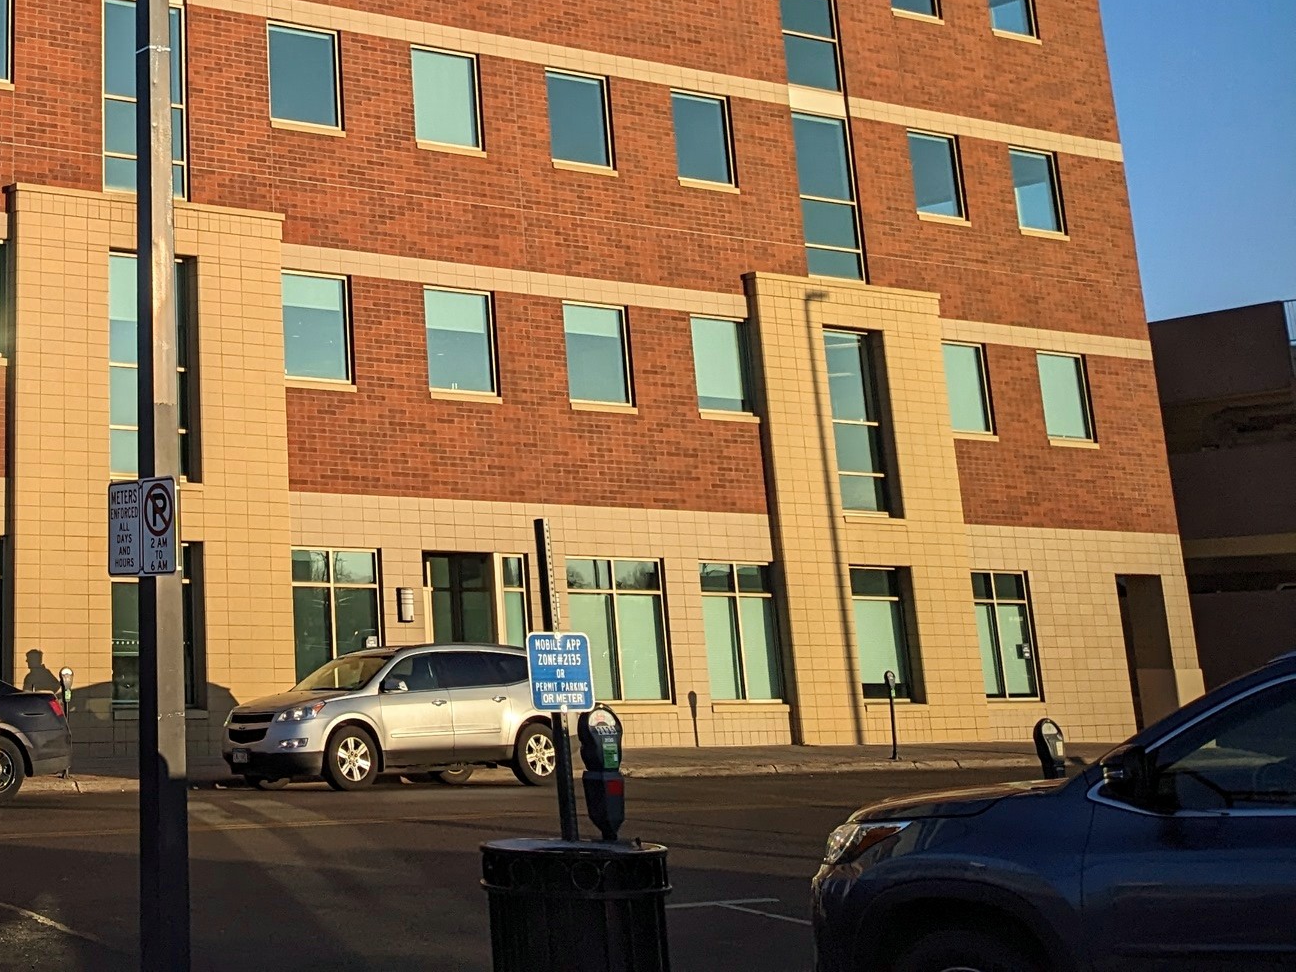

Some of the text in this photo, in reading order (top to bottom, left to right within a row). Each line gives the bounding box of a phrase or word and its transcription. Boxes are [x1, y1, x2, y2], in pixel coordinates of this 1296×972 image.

[111, 489, 137, 505] METERS
[111, 506, 138, 519] ENFORCED
[119, 522, 129, 531] ALL
[117, 534, 132, 544] DAYS
[151, 537, 167, 548] 2 AM
[119, 546, 131, 555] AND
[155, 550, 163, 559] TO
[115, 558, 134, 568] HOURS
[151, 560, 167, 571] 6 AM
[535, 639, 581, 650] MOBILE APP
[538, 654, 581, 665] ZONE#2135
[556, 669, 565, 678] OR
[536, 682, 588, 691] PERMIT PARKING
[543, 693, 583, 703] OR METER
